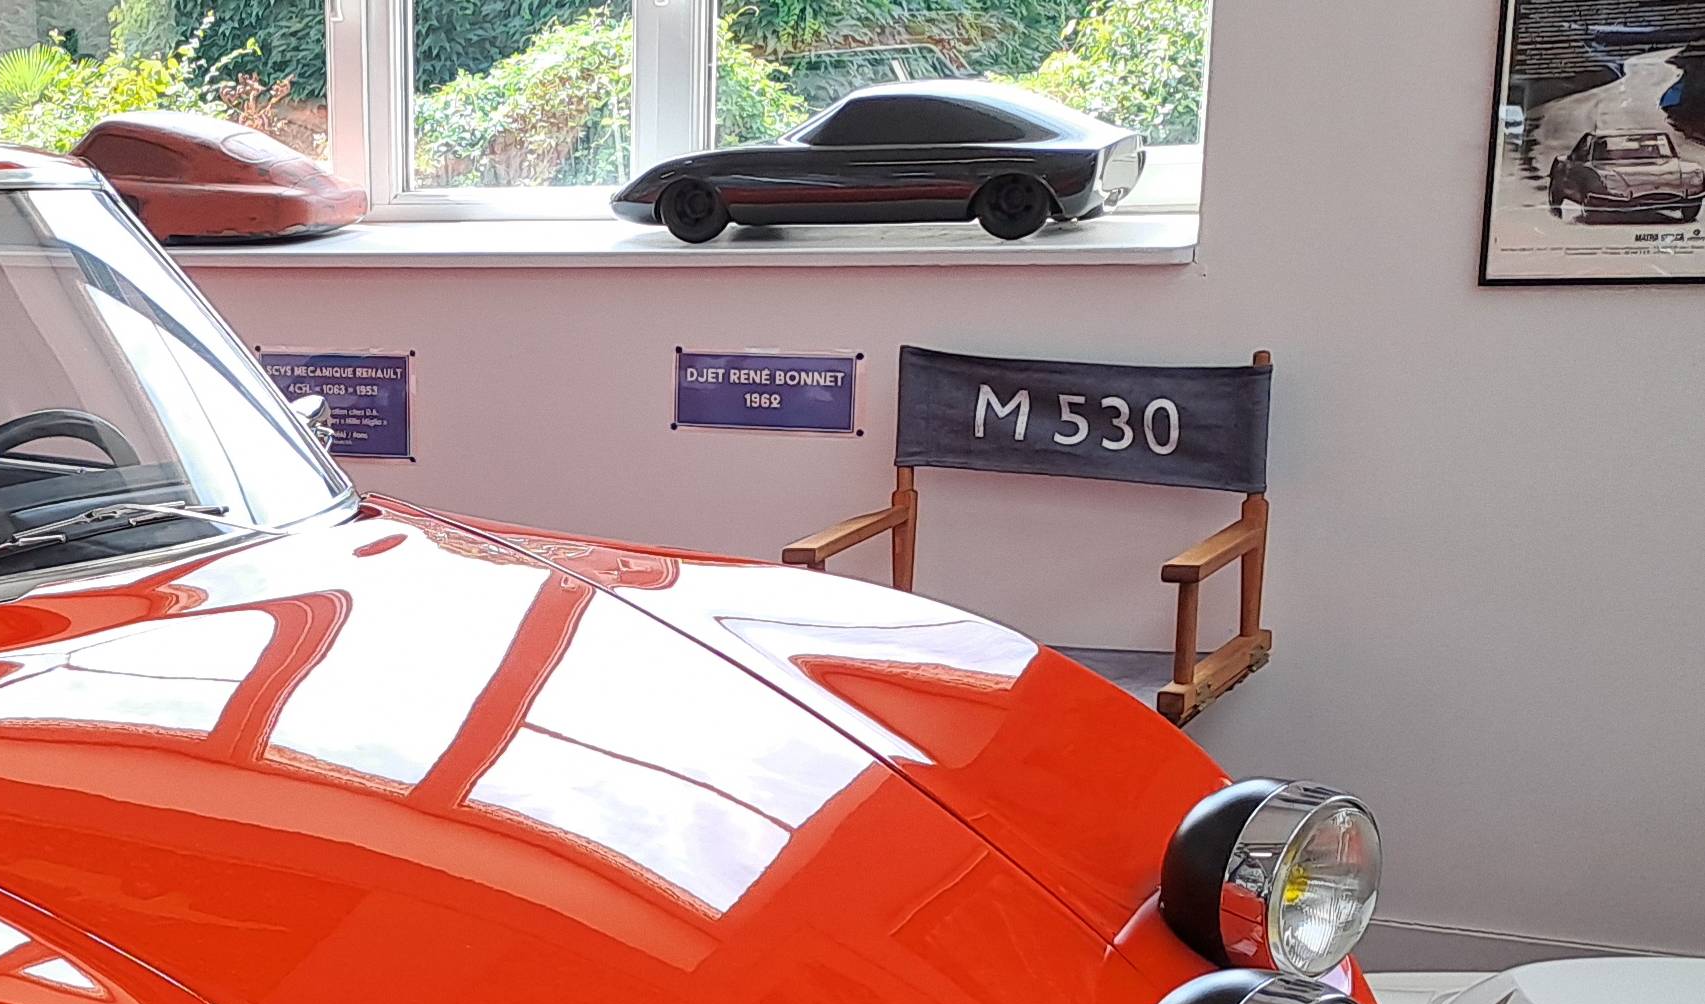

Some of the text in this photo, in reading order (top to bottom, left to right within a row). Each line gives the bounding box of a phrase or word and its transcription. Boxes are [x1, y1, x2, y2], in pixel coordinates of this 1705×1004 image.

[294, 366, 354, 378] MECANIQUE
[356, 367, 402, 379] RENAULT
[686, 367, 845, 386] DJET RENÉ BONNET
[323, 384, 345, 395] 1063
[356, 385, 378, 395] 1953
[744, 393, 781, 408] 1962
[974, 384, 1181, 456] M 530
